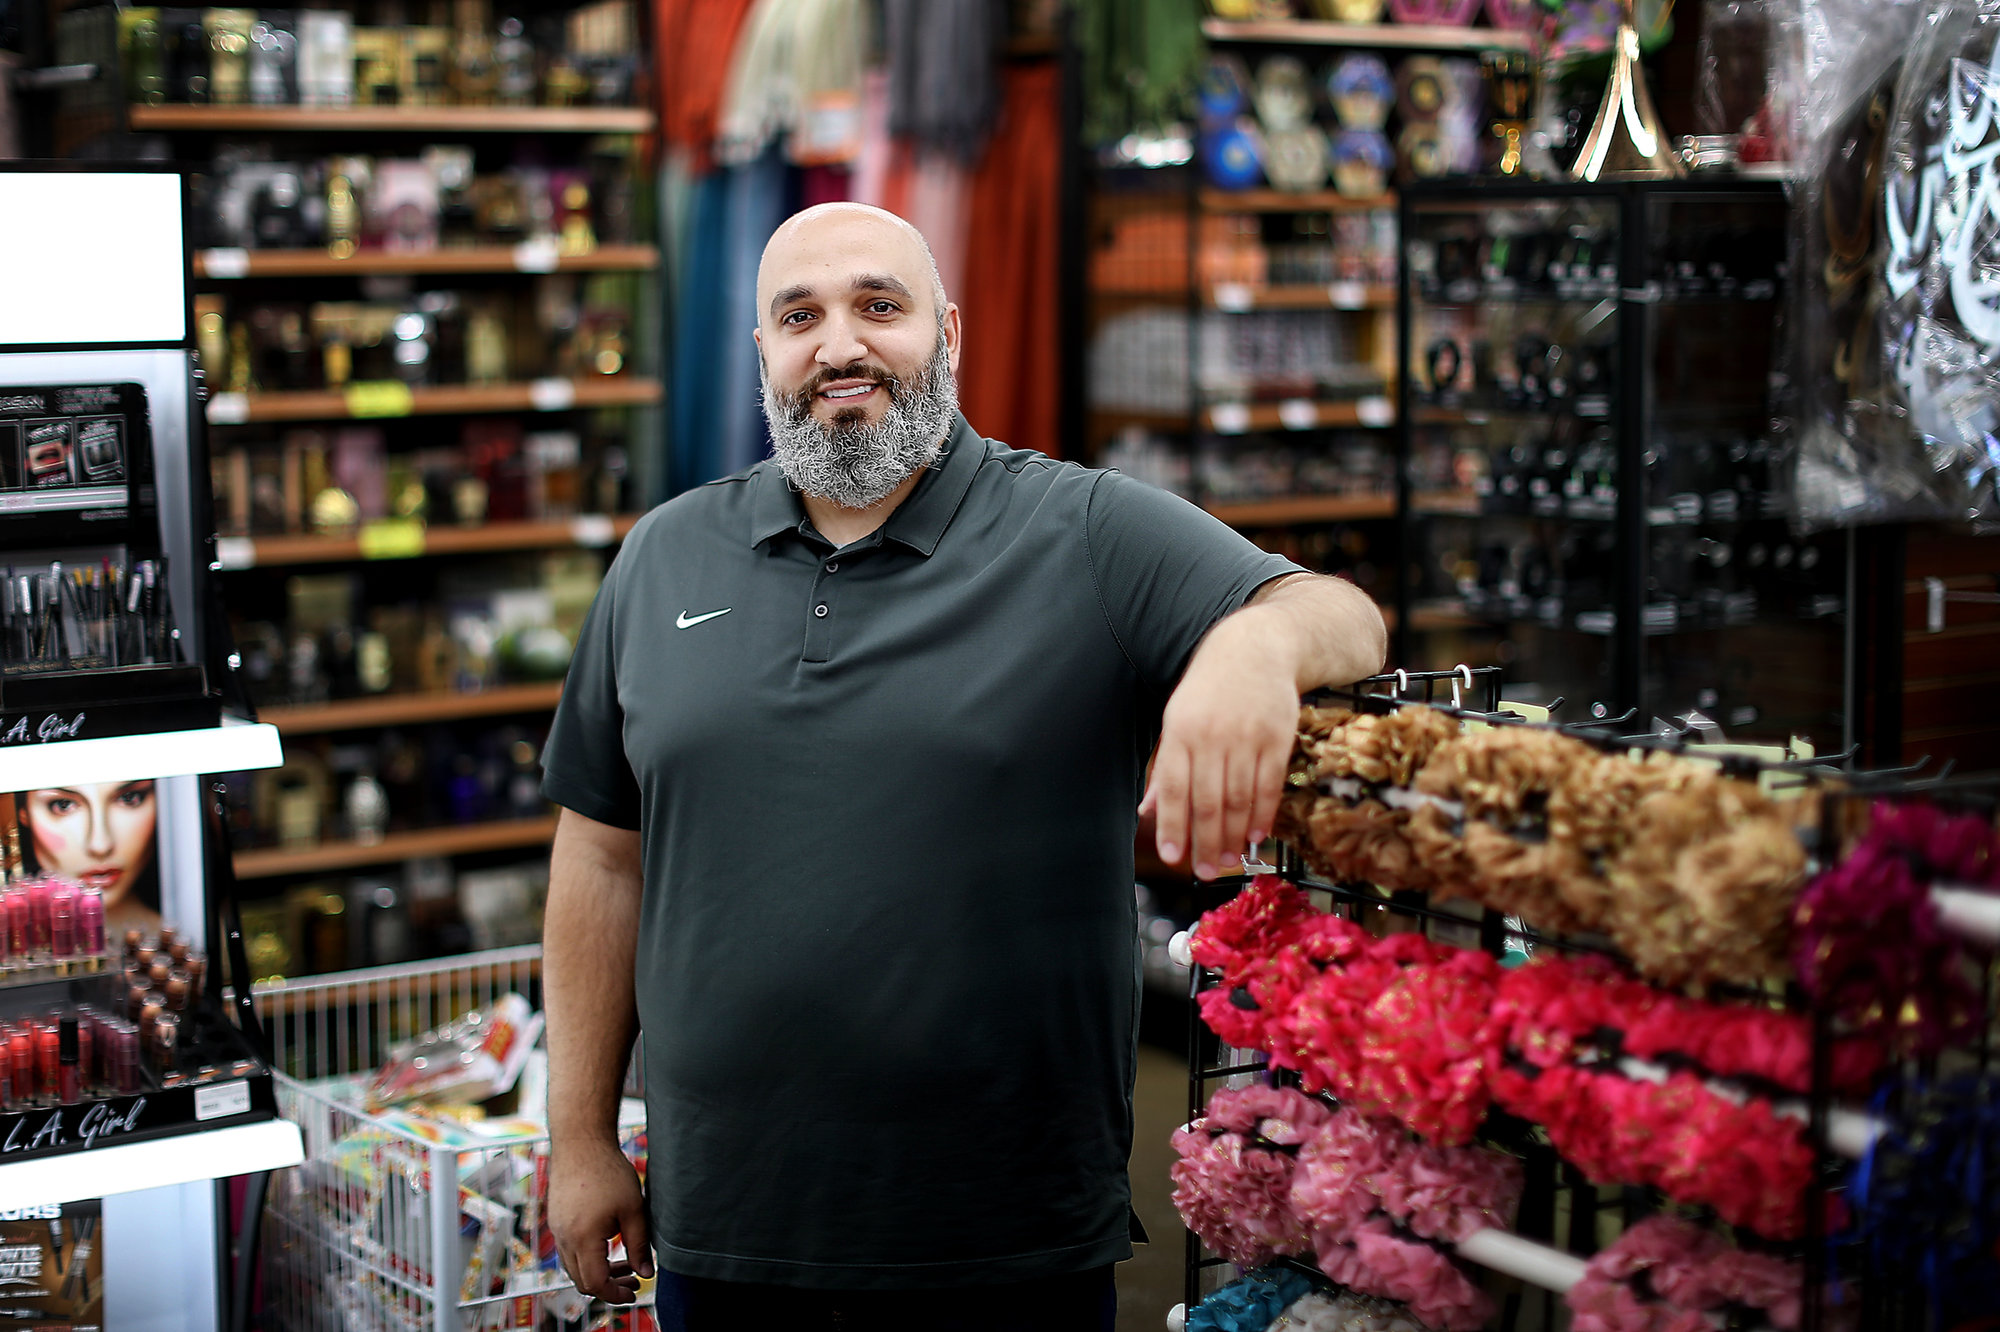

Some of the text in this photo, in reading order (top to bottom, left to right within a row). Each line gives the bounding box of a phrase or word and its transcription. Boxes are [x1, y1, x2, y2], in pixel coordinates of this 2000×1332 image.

[0, 711, 86, 743] .A. Girl
[3, 1096, 147, 1152] L.A. Girl
